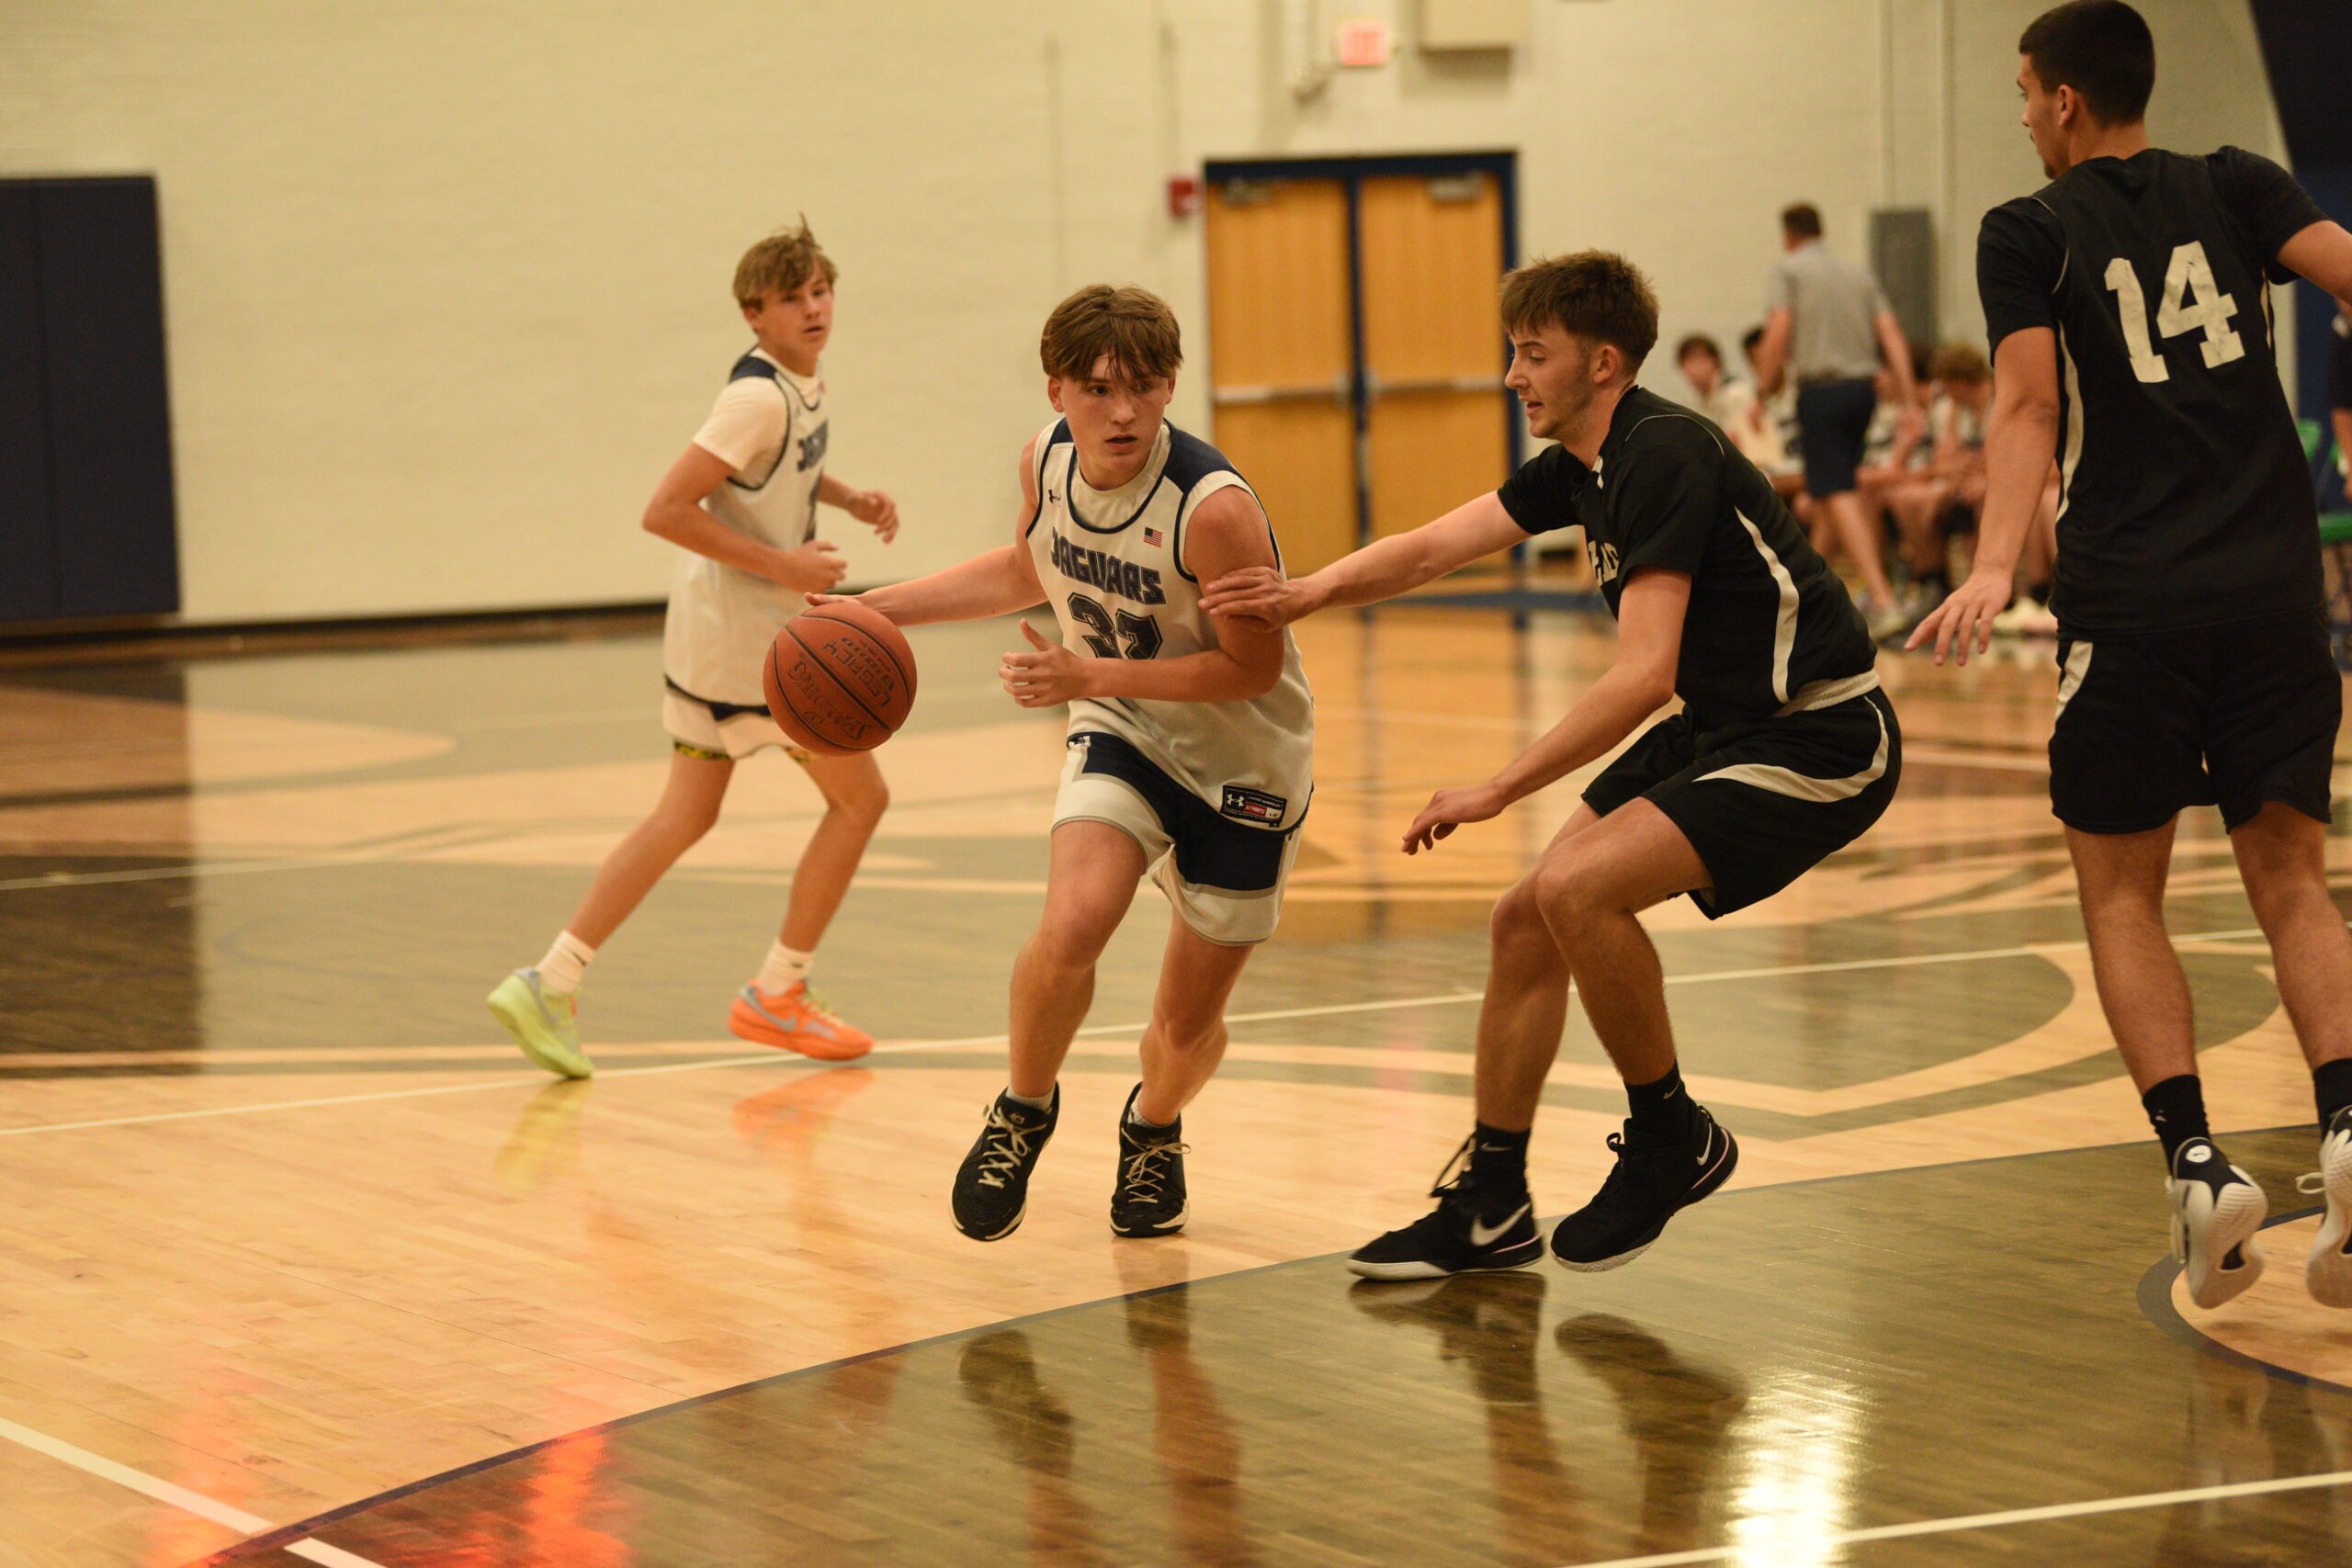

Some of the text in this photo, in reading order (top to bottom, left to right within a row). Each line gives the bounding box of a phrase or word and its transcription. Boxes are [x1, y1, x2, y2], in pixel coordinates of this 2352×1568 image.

[2104, 240, 2245, 383] 14
[1051, 526, 1167, 605] JAGUARS
[786, 660, 872, 741] SPALDING
